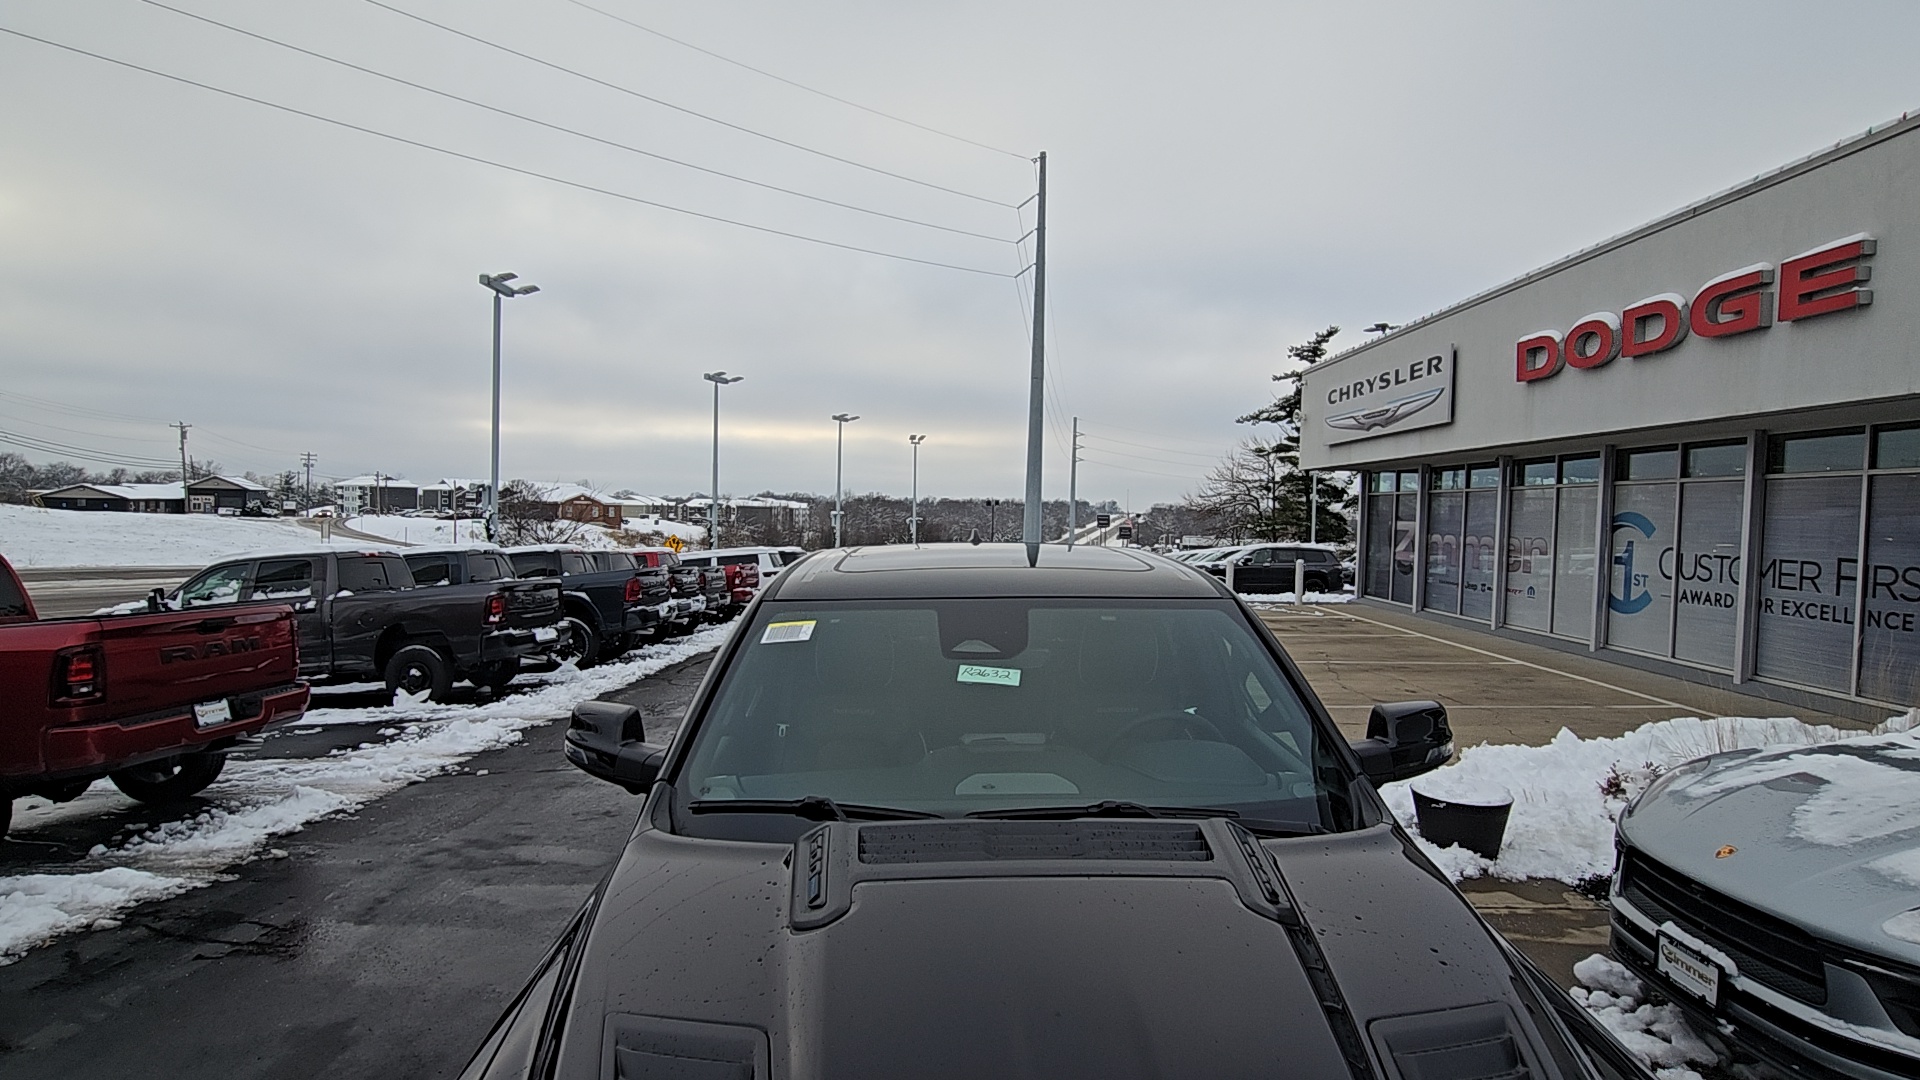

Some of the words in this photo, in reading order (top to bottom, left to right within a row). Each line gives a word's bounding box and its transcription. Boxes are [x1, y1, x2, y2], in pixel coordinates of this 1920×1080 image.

[1517, 238, 1875, 382] DODGE
[1327, 355, 1443, 405] CHRYSLER
[1390, 520, 1549, 574] Zmmer
[1679, 589, 1735, 608] AWARD
[1781, 600, 1915, 632] EXCELLNCE
[160, 636, 260, 665] RAM
[961, 667, 1012, 680] R2632
[1661, 943, 1716, 987] Zimmer
